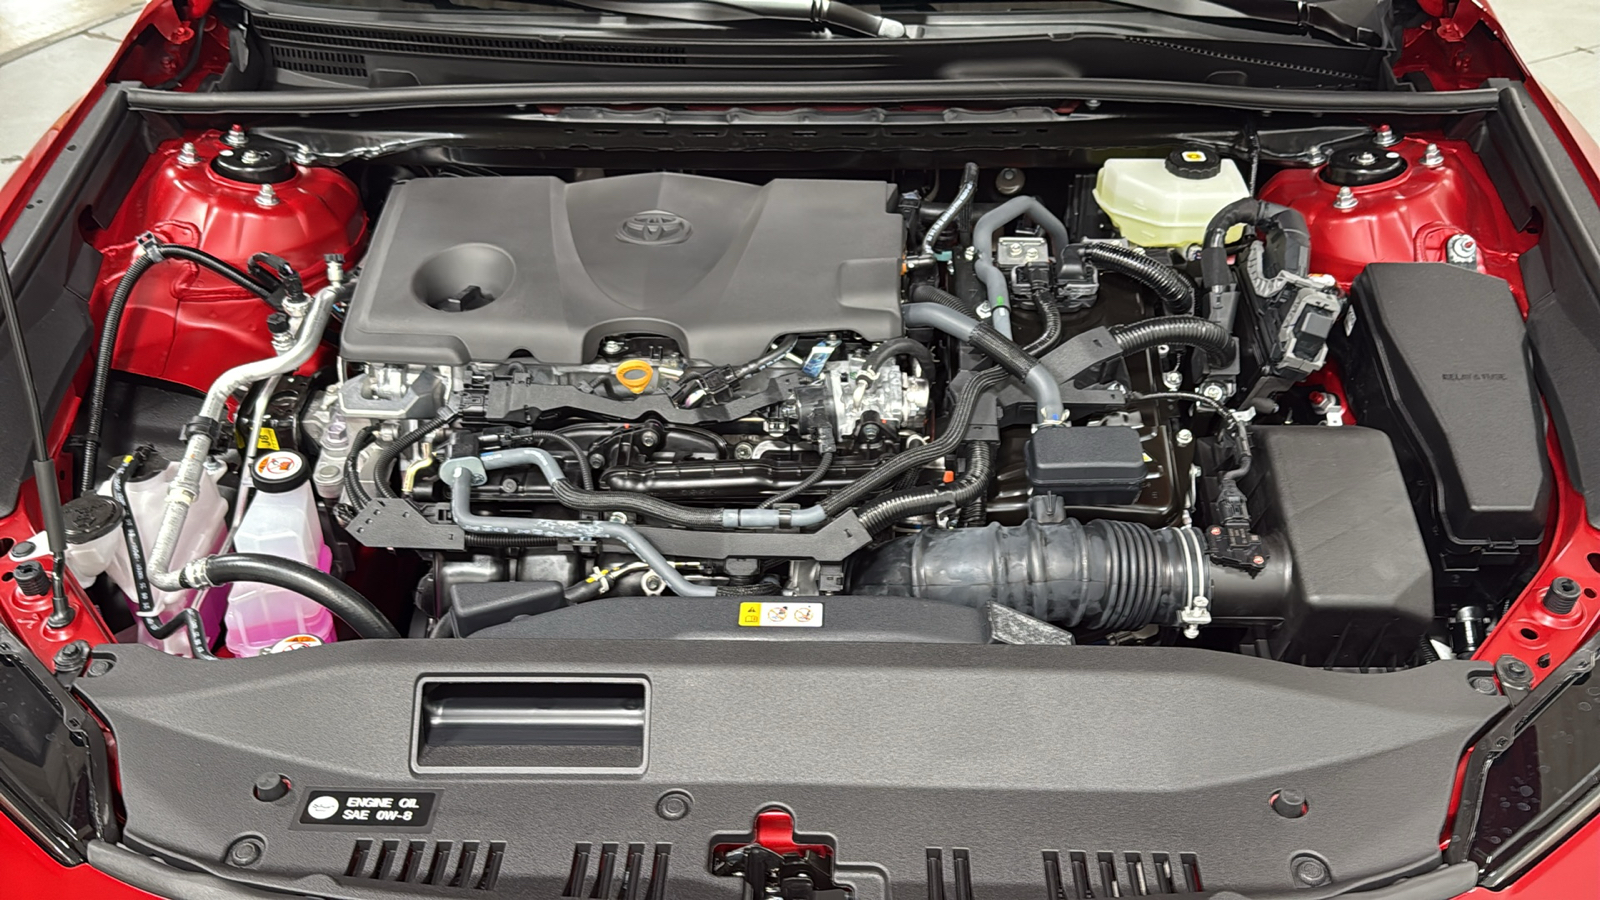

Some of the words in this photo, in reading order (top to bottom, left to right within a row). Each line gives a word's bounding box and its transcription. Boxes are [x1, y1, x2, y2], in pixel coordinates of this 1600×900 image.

[346, 797, 394, 808] ENGINE
[398, 798, 419, 808] OIL
[342, 810, 370, 820] SAE
[375, 810, 413, 821] 0W-8
